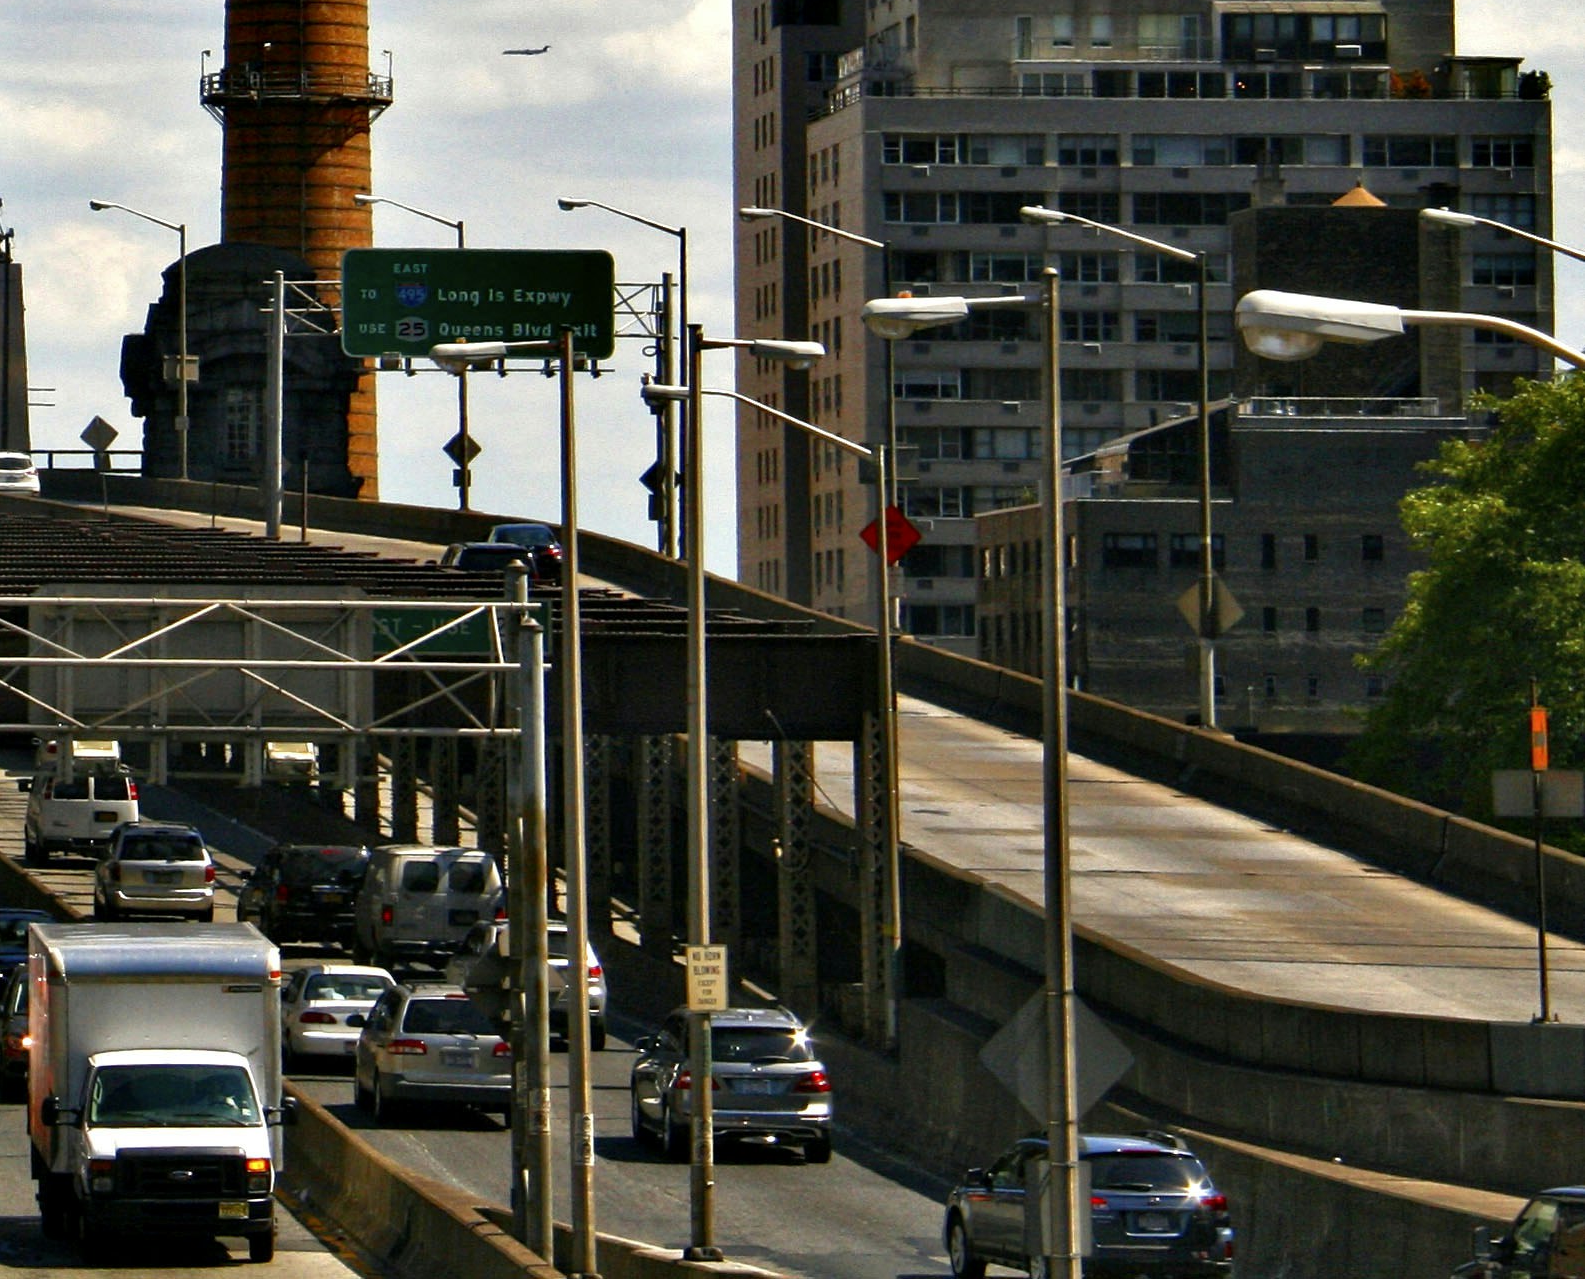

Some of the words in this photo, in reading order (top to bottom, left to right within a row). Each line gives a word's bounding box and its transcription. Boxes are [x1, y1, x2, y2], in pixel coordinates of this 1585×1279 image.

[393, 264, 428, 273] EAST
[360, 289, 376, 300] TO
[398, 288, 424, 301] 495
[438, 289, 480, 306] Long
[488, 289, 504, 302] Is
[514, 289, 571, 306] Expwy
[359, 323, 386, 334] USE
[398, 323, 426, 336] 25
[439, 324, 503, 337] Queens
[513, 323, 552, 337] Blvd
[563, 323, 597, 337] xit
